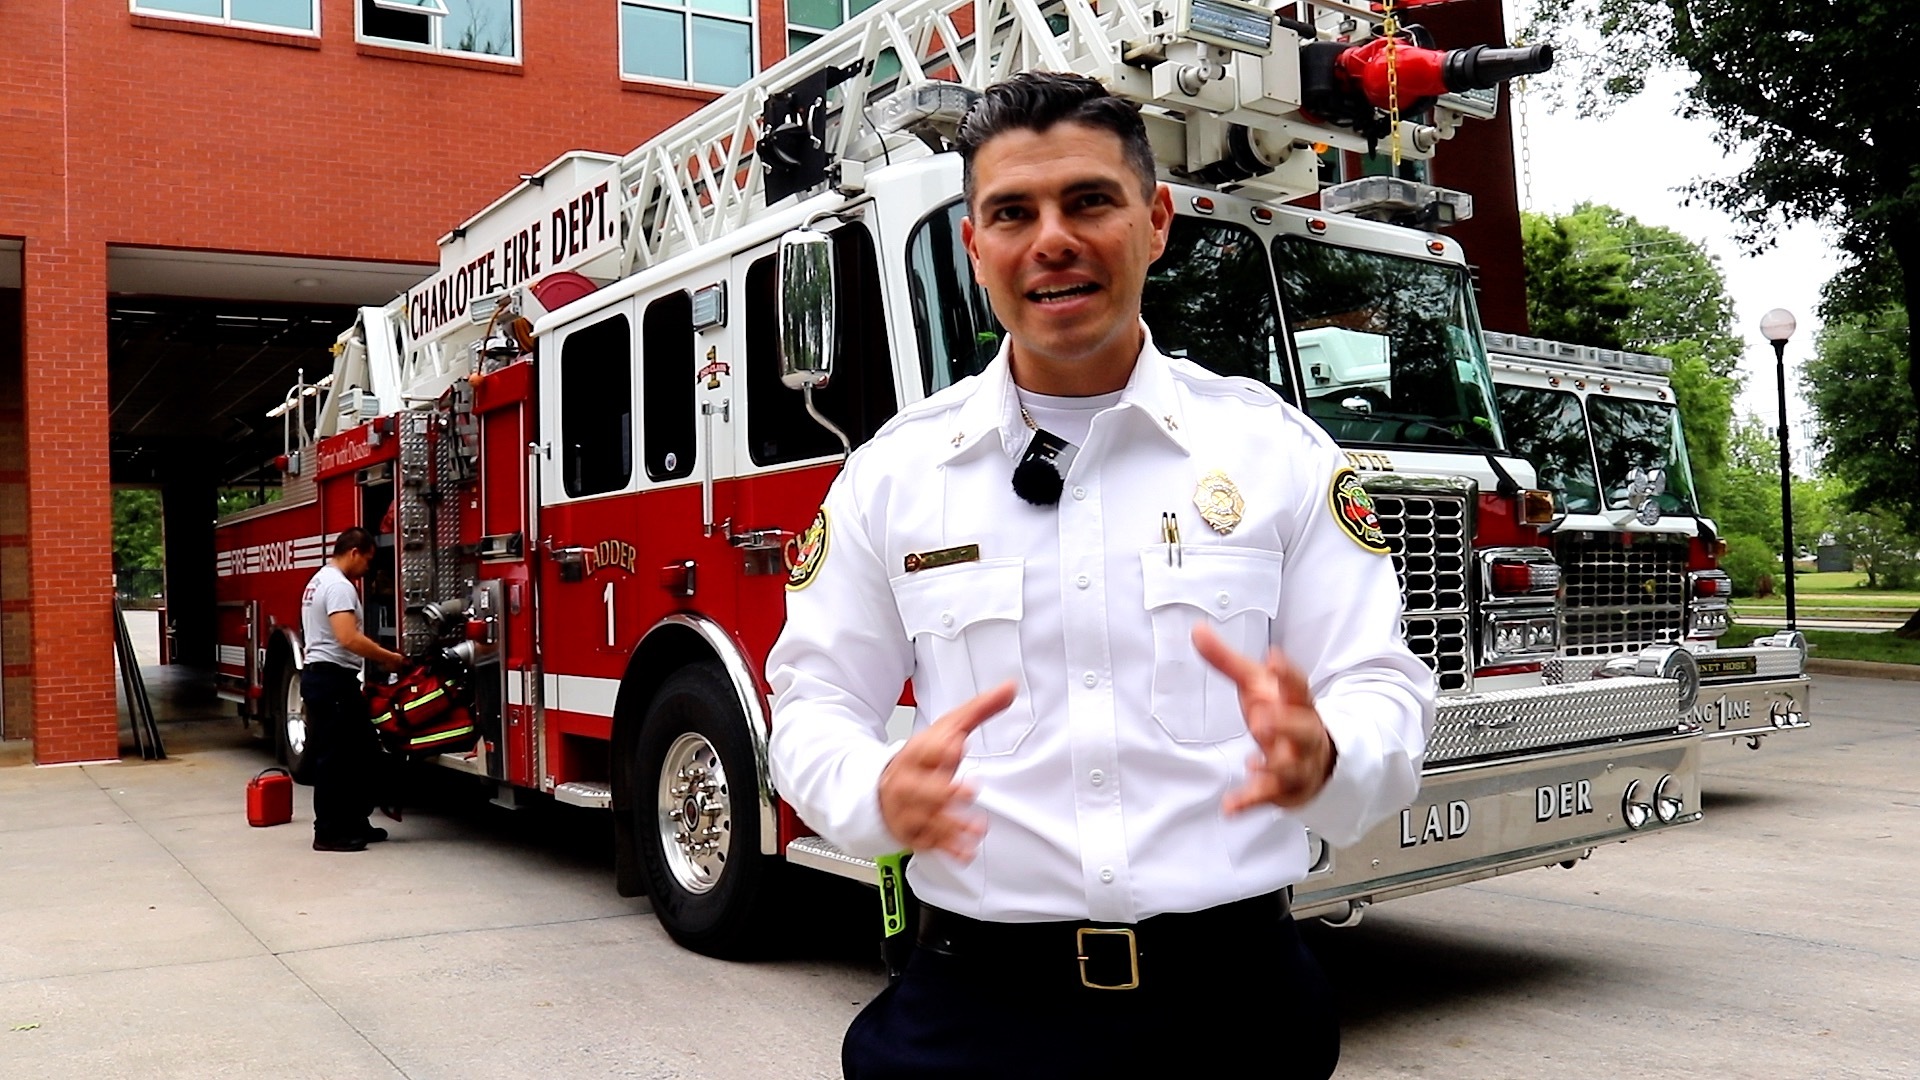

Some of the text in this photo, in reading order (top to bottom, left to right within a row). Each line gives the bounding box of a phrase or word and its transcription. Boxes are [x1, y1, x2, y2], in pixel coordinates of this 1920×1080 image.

[410, 181, 615, 341] CHARLOTTE FIRE DEPT.
[259, 540, 293, 572] RESCUE
[584, 539, 637, 576] LADDER
[603, 582, 615, 647] 1
[1722, 661, 1747, 671] HOSE
[1400, 779, 1594, 849] LAD DER
